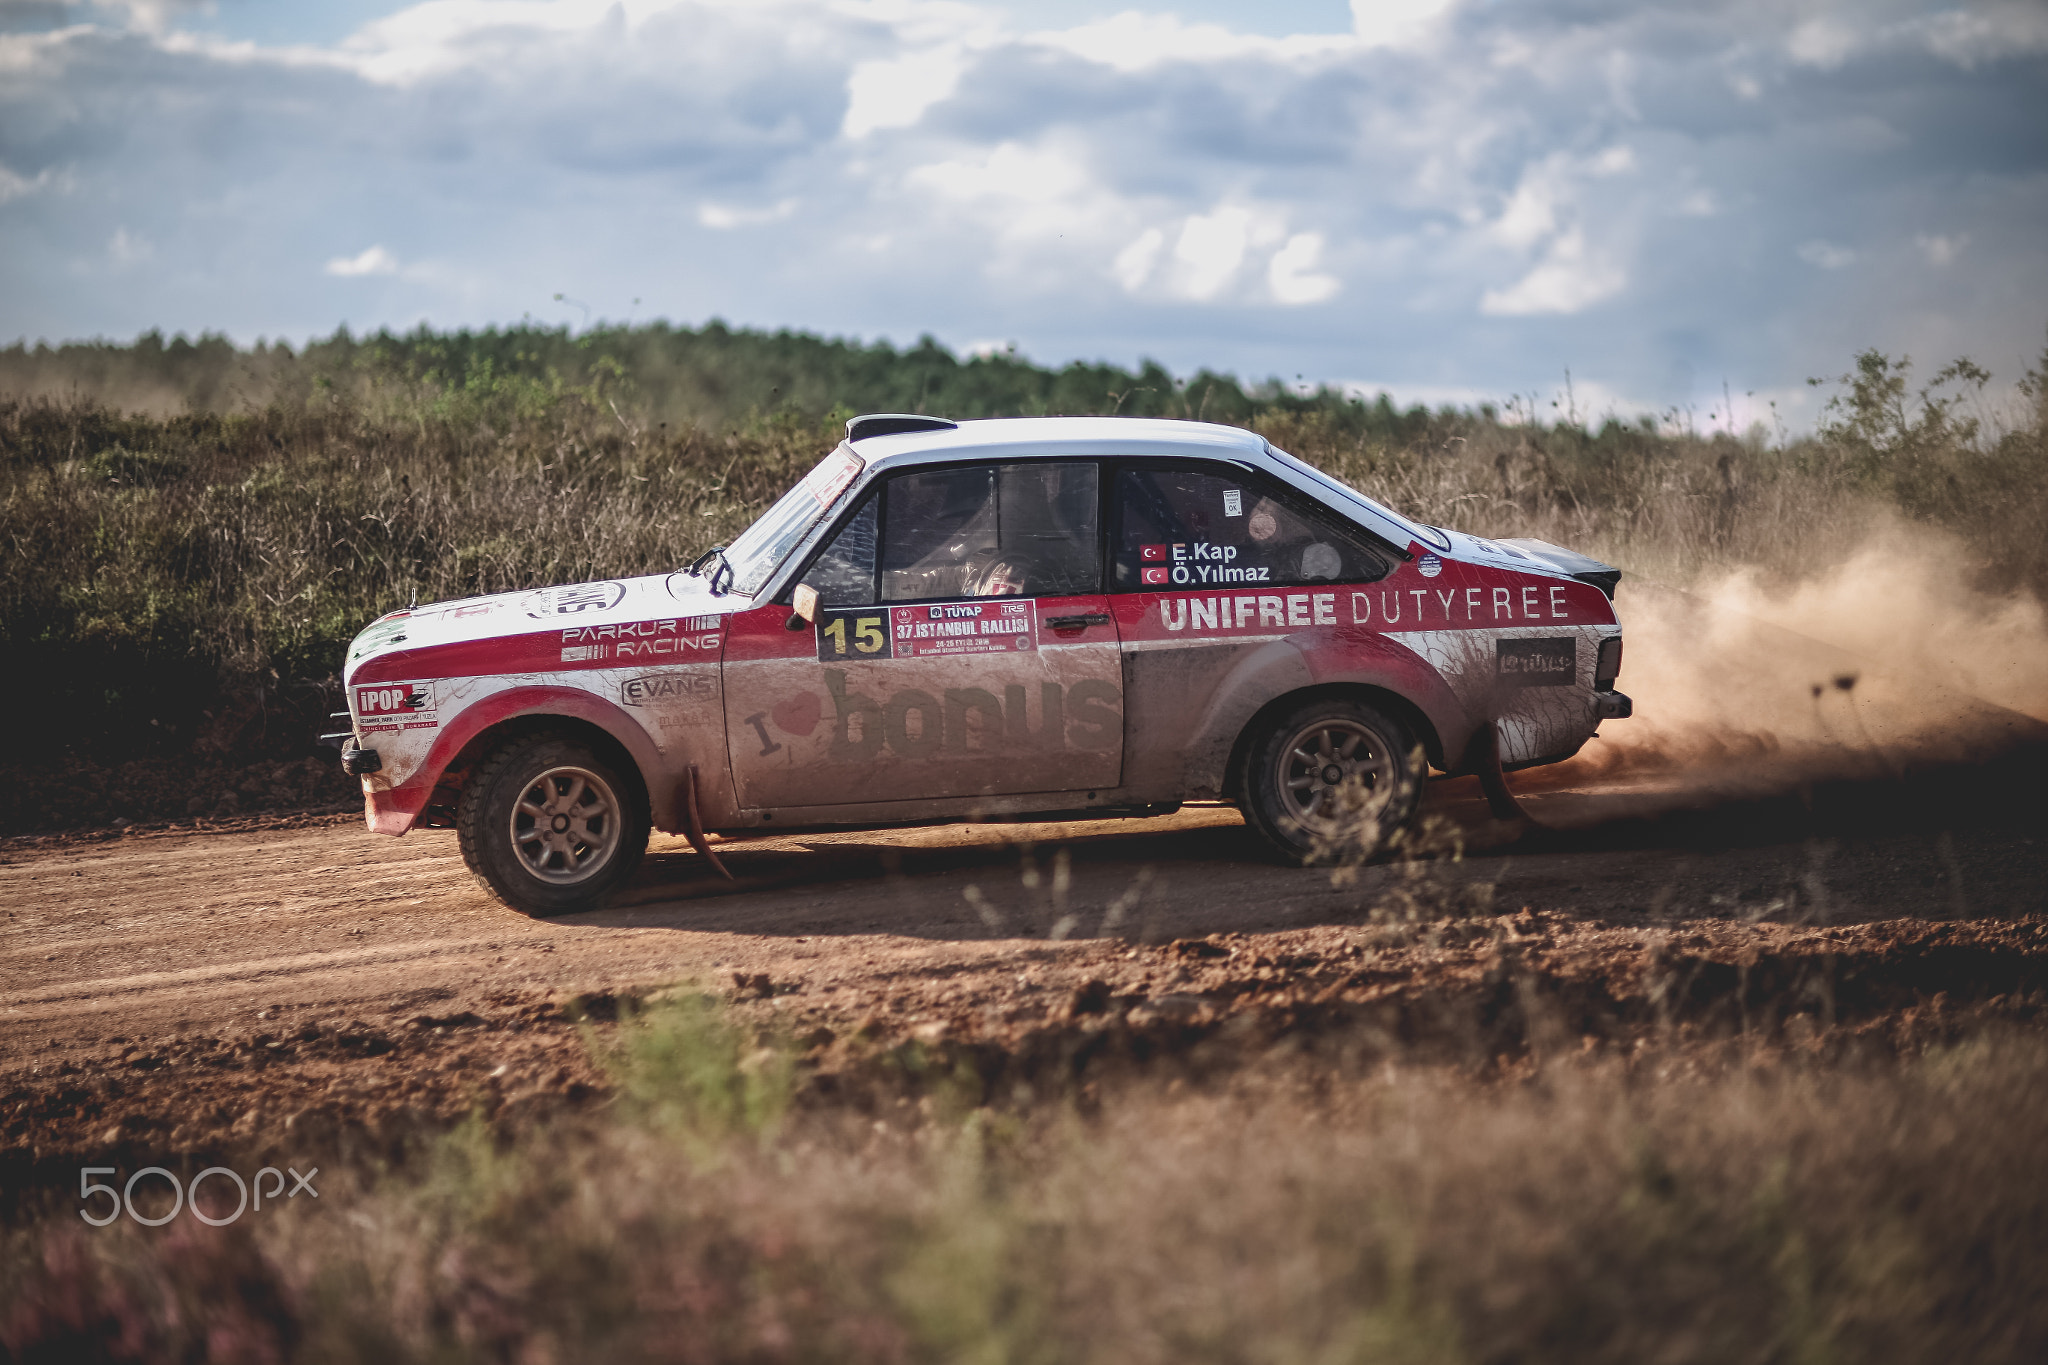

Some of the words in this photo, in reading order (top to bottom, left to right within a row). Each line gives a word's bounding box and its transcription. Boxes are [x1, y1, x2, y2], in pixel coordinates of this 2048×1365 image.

[1172, 543, 1237, 563] E.Kap
[1172, 562, 1270, 584] Ö.Yılmaz
[945, 606, 983, 618] TÜYAP
[1002, 604, 1025, 613] TRS
[1160, 593, 1337, 631] UNIFREE
[1351, 586, 1568, 624] DUTYFREE
[562, 619, 677, 643] PARKUR
[824, 617, 884, 654] 15
[981, 616, 1029, 634] RALLİSİ
[616, 634, 720, 657] RACING
[627, 677, 711, 698] EVANS
[360, 689, 404, 712] iPOP
[744, 711, 782, 757] I
[824, 668, 1123, 760] bonus
